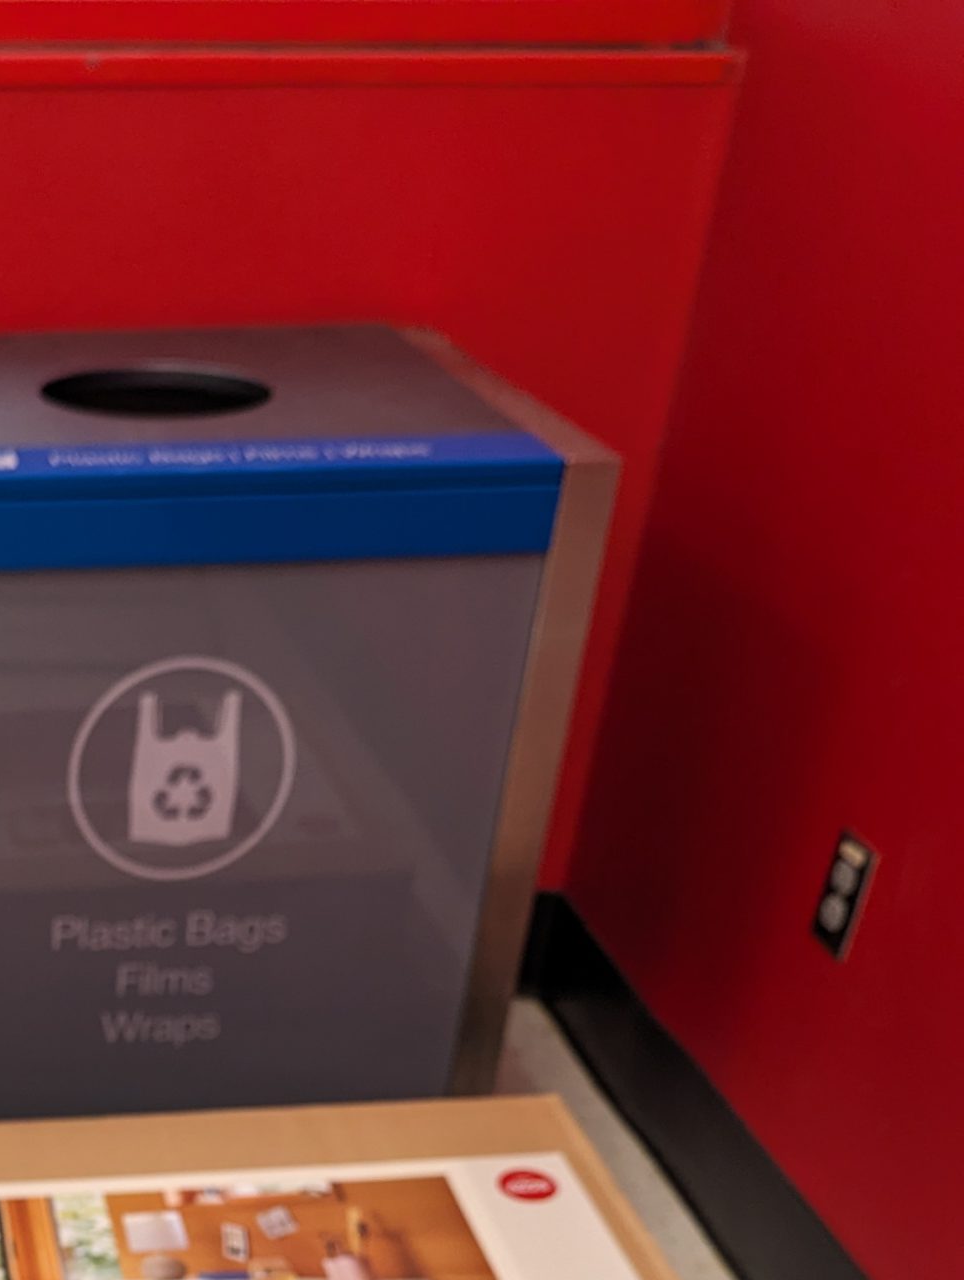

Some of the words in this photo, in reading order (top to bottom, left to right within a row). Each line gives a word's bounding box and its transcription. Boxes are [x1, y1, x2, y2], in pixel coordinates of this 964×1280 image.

[50, 914, 177, 951] Plastic
[185, 908, 287, 953] Bags
[116, 961, 214, 997] Films
[100, 1010, 221, 1048] Wraps
